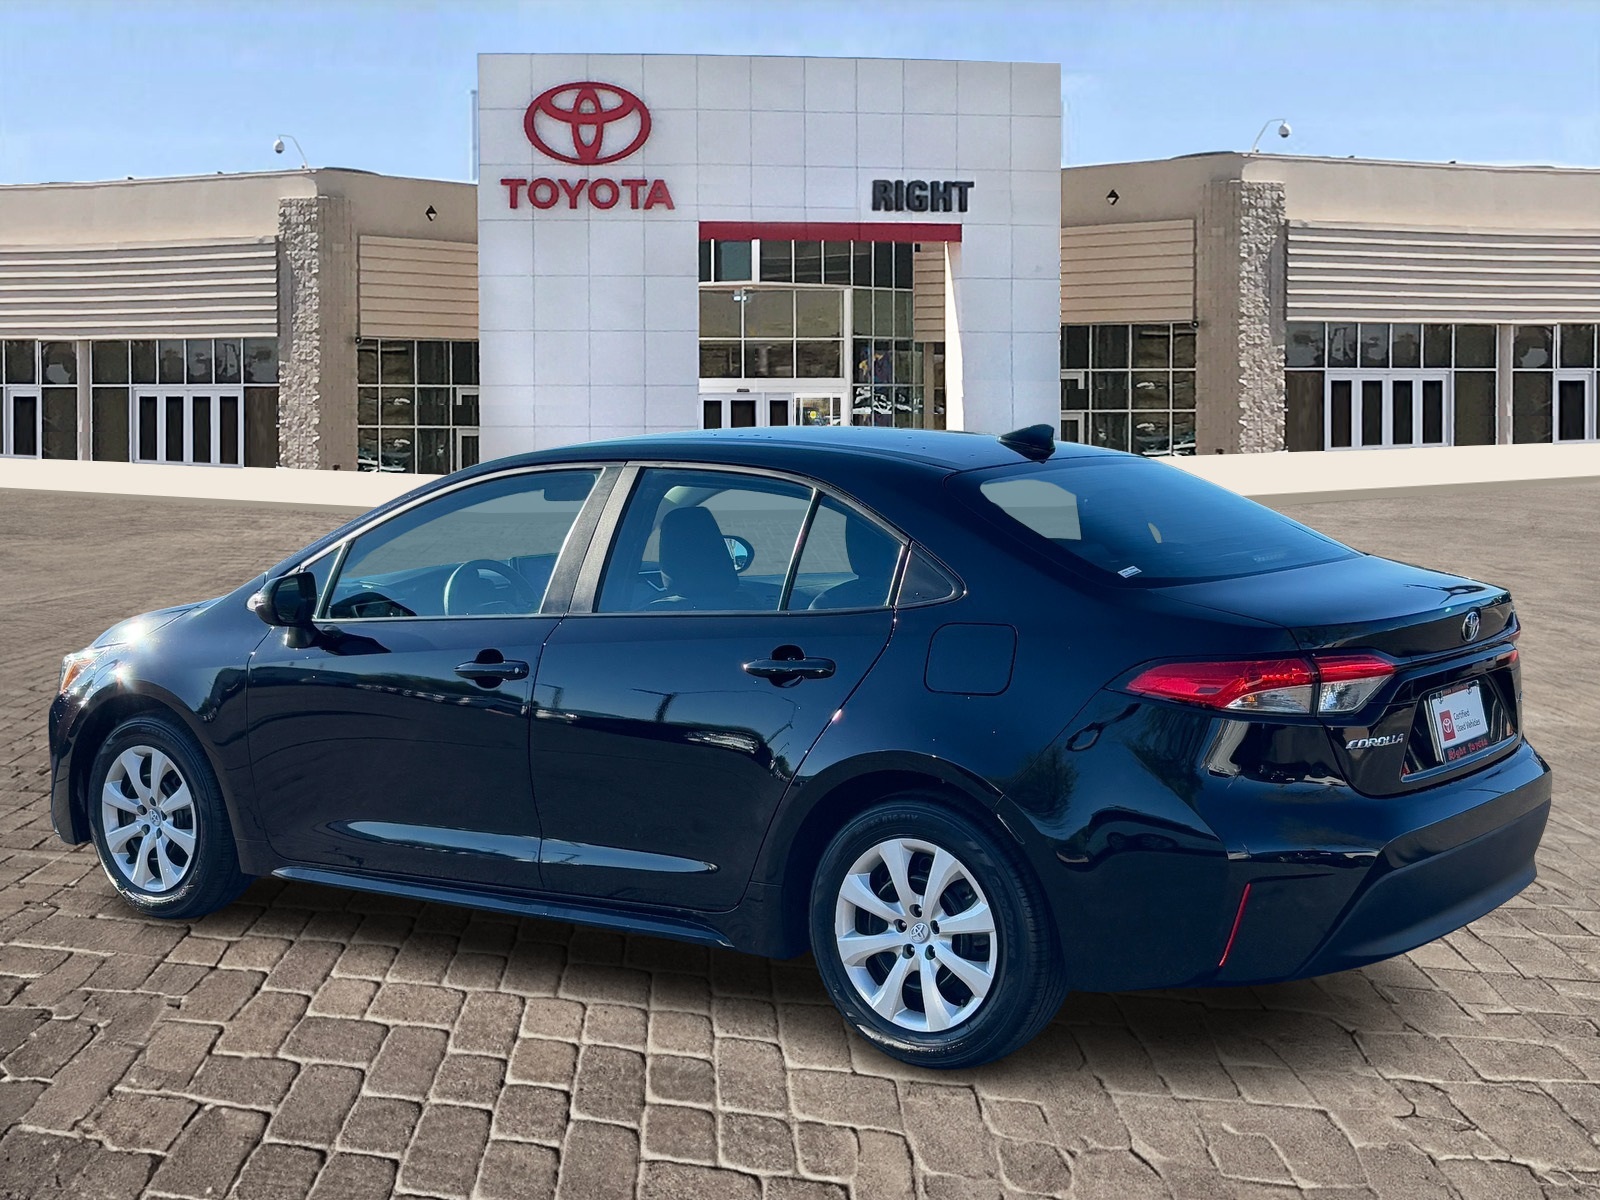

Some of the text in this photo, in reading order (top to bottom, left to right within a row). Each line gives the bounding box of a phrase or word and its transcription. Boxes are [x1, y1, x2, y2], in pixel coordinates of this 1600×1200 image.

[500, 177, 675, 210] TOYOTA
[872, 179, 975, 212] RIGHT
[1453, 708, 1470, 721] Certified
[1345, 733, 1404, 749] COROLLA
